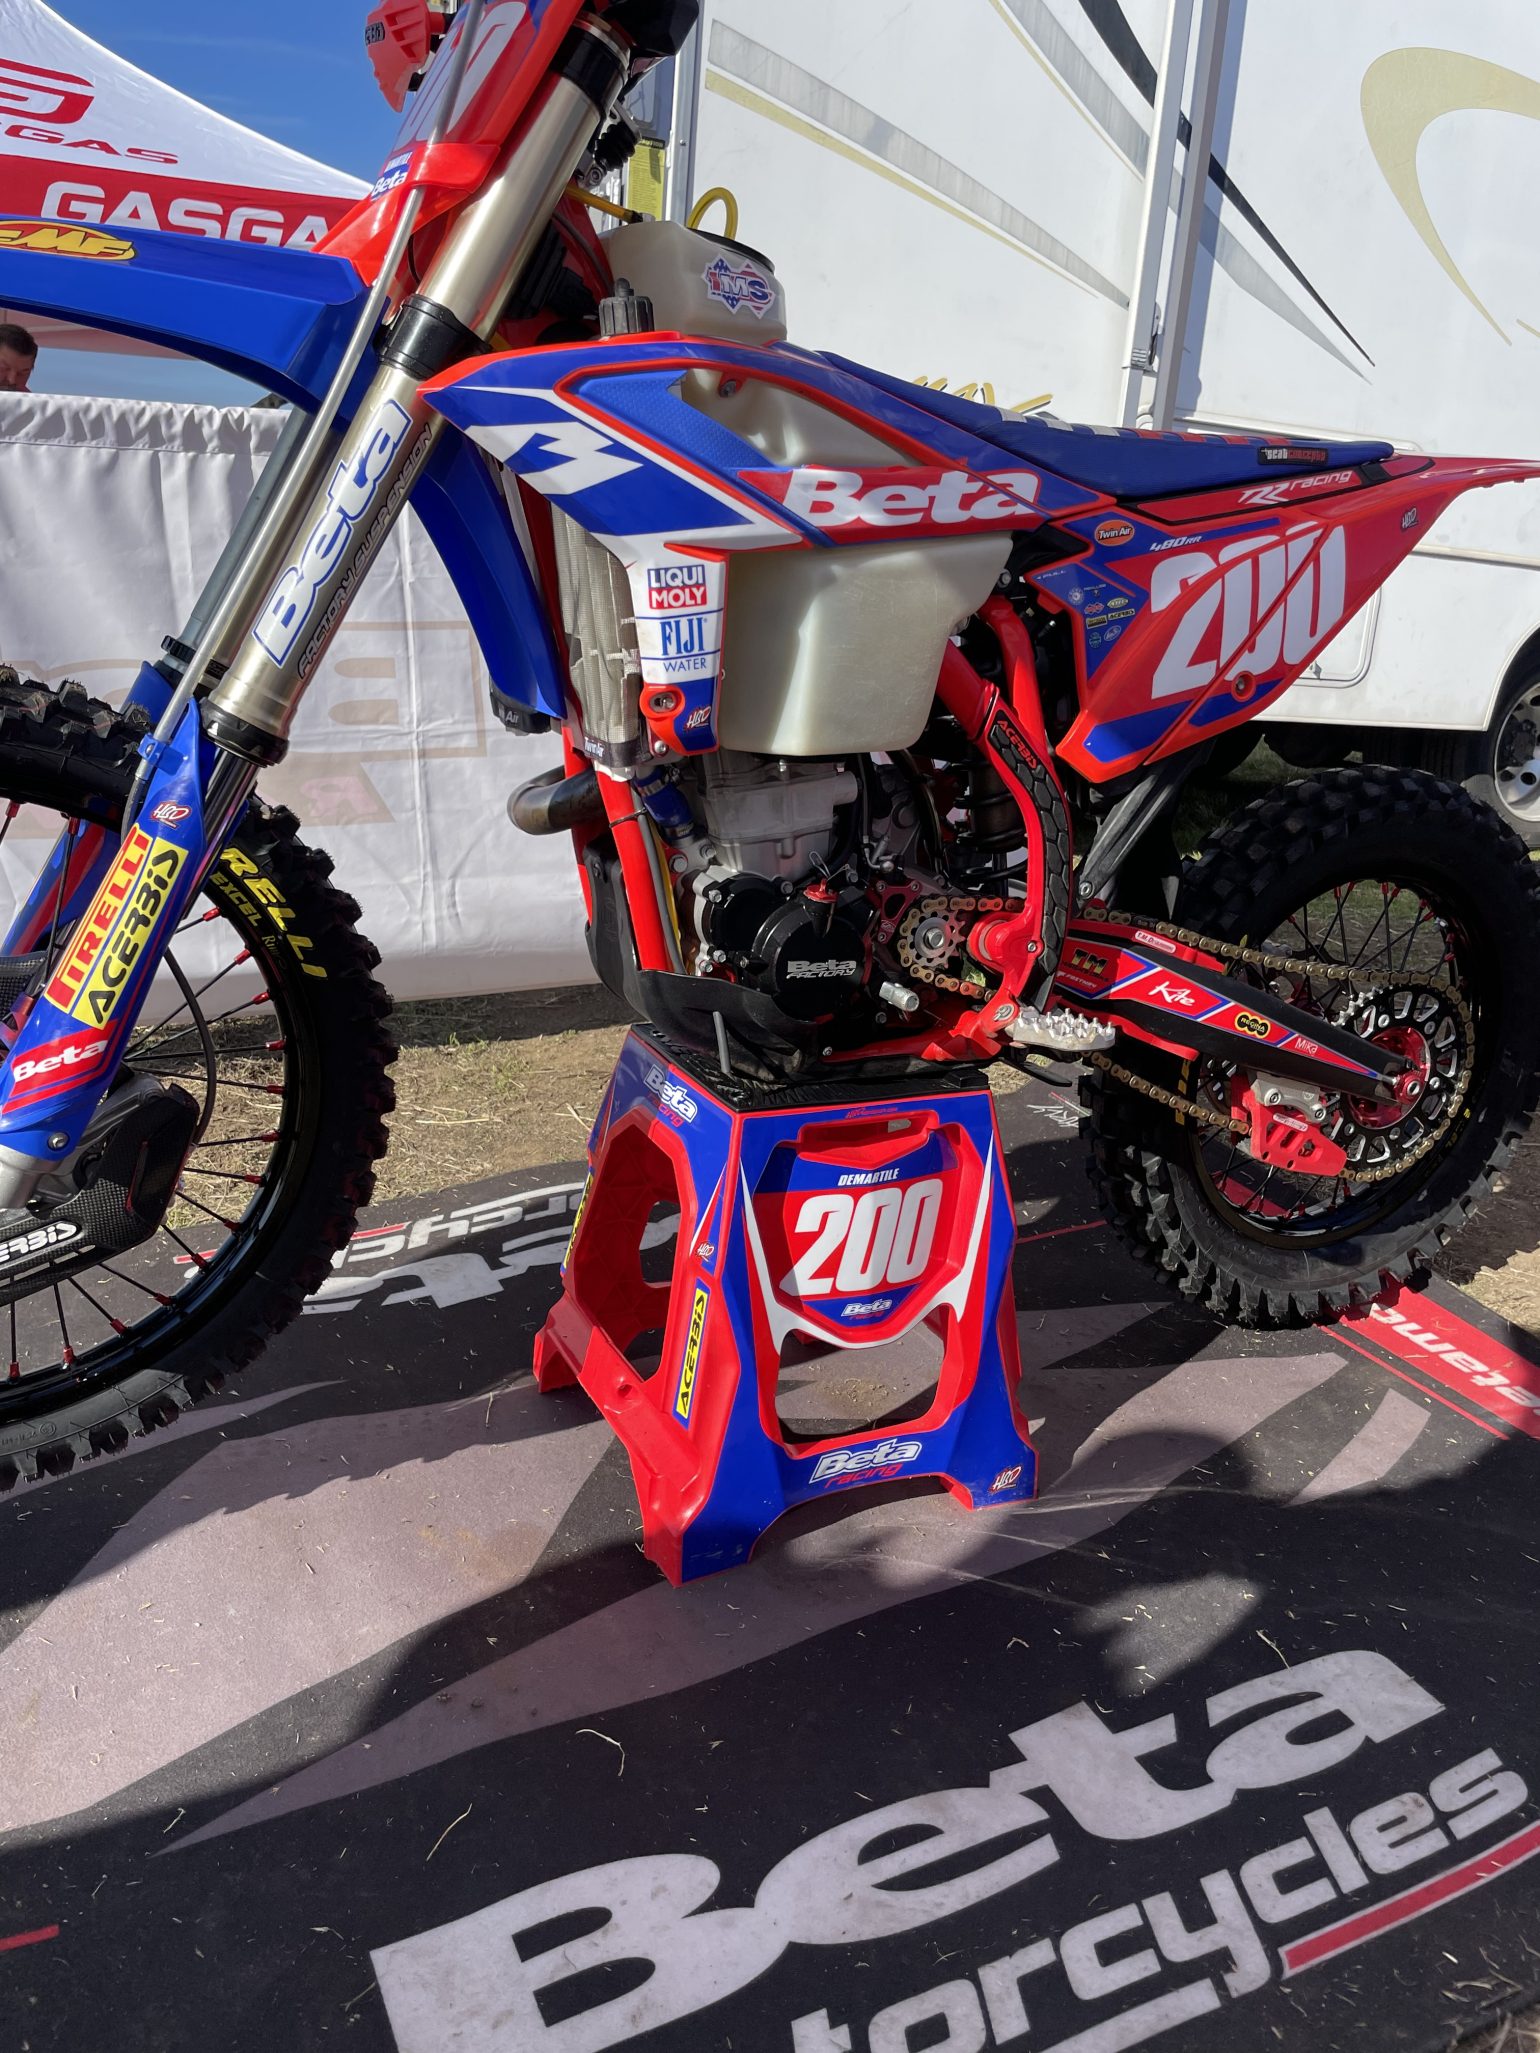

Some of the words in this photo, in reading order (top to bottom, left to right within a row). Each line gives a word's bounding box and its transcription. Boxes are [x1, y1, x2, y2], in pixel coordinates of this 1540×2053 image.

[0, 122, 178, 165] GAS
[781, 468, 1040, 527] Beta
[1290, 470, 1353, 491] racing
[253, 400, 411, 667] Beta
[297, 568, 356, 679] FACTORY
[351, 423, 432, 579] SUSPENSION
[1098, 530, 1119, 540] Twin
[1119, 527, 1132, 536] Air
[650, 565, 704, 588] LIQUI
[651, 586, 706, 609] MOLY
[1150, 520, 1346, 700] 200
[659, 616, 705, 656] FIJI
[663, 658, 707, 673] WATER
[209, 874, 258, 928] EXCEL
[88, 848, 179, 1024] ACERBIS
[786, 968, 856, 979] FACTORY
[788, 959, 857, 973] Beta
[1148, 980, 1196, 1007] Kite
[1240, 1016, 1266, 1033] REGINA
[12, 1038, 109, 1083] Beta
[643, 1064, 698, 1123] Beta
[837, 1168, 900, 1187] DEMARTILE
[778, 1178, 944, 1297] 200
[840, 1298, 893, 1317] Beta
[682, 1294, 705, 1415] ACERBIS
[808, 1438, 923, 1485] Beta
[824, 1463, 903, 1489] racing
[369, 1650, 1446, 2053] Beta
